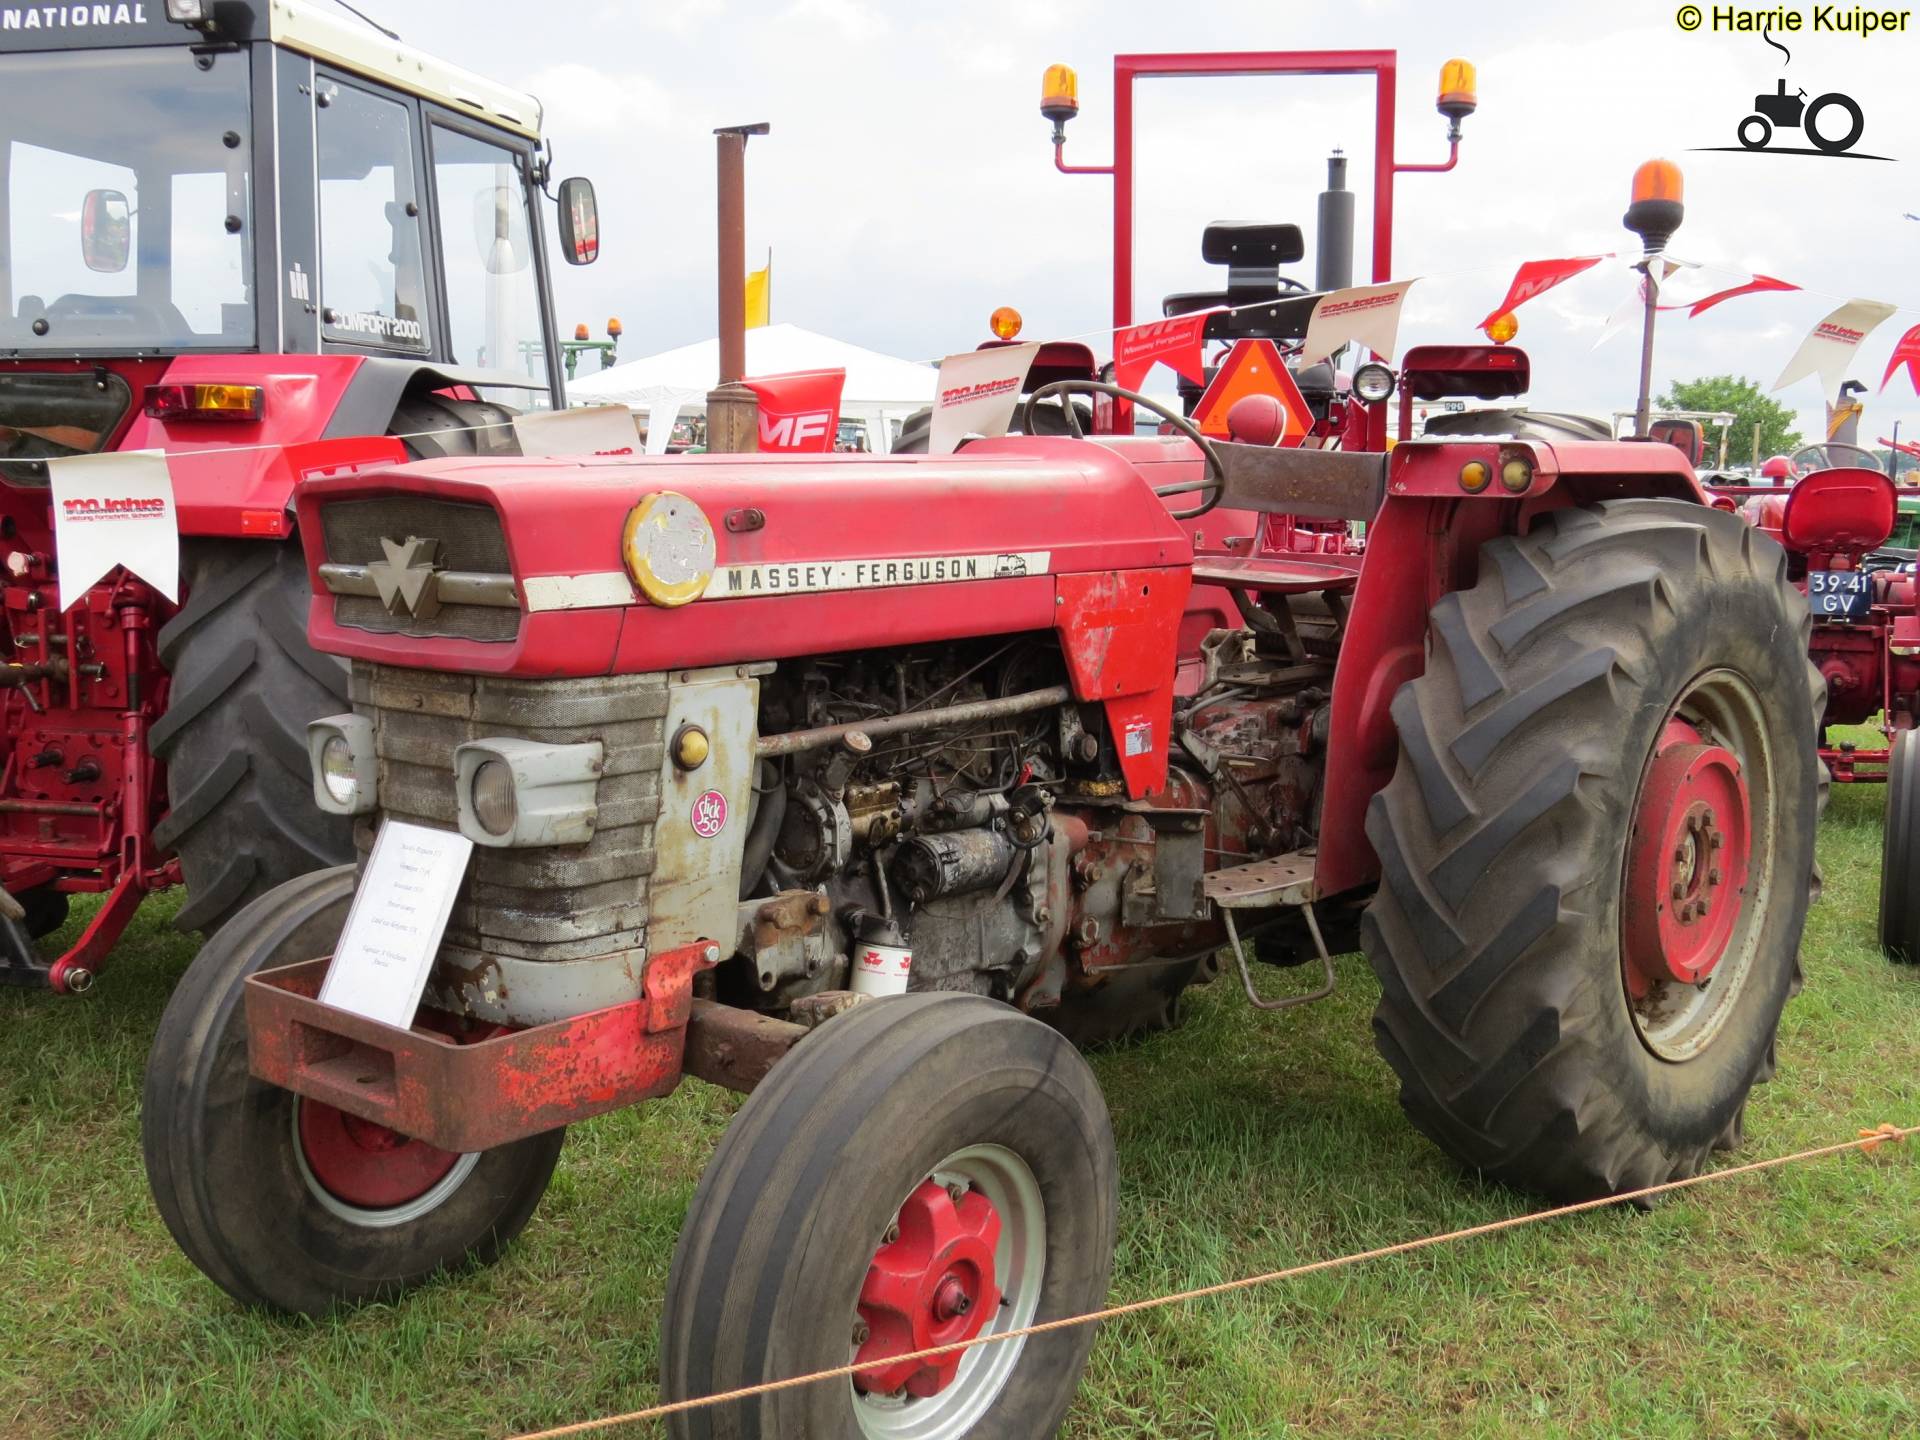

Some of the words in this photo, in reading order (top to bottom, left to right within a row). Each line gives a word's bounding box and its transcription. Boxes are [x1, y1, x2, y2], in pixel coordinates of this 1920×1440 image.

[2, 3, 147, 30] NATIONAL
[758, 412, 828, 447] MF
[1823, 594, 1855, 612] GV
[702, 817, 719, 832] 50
